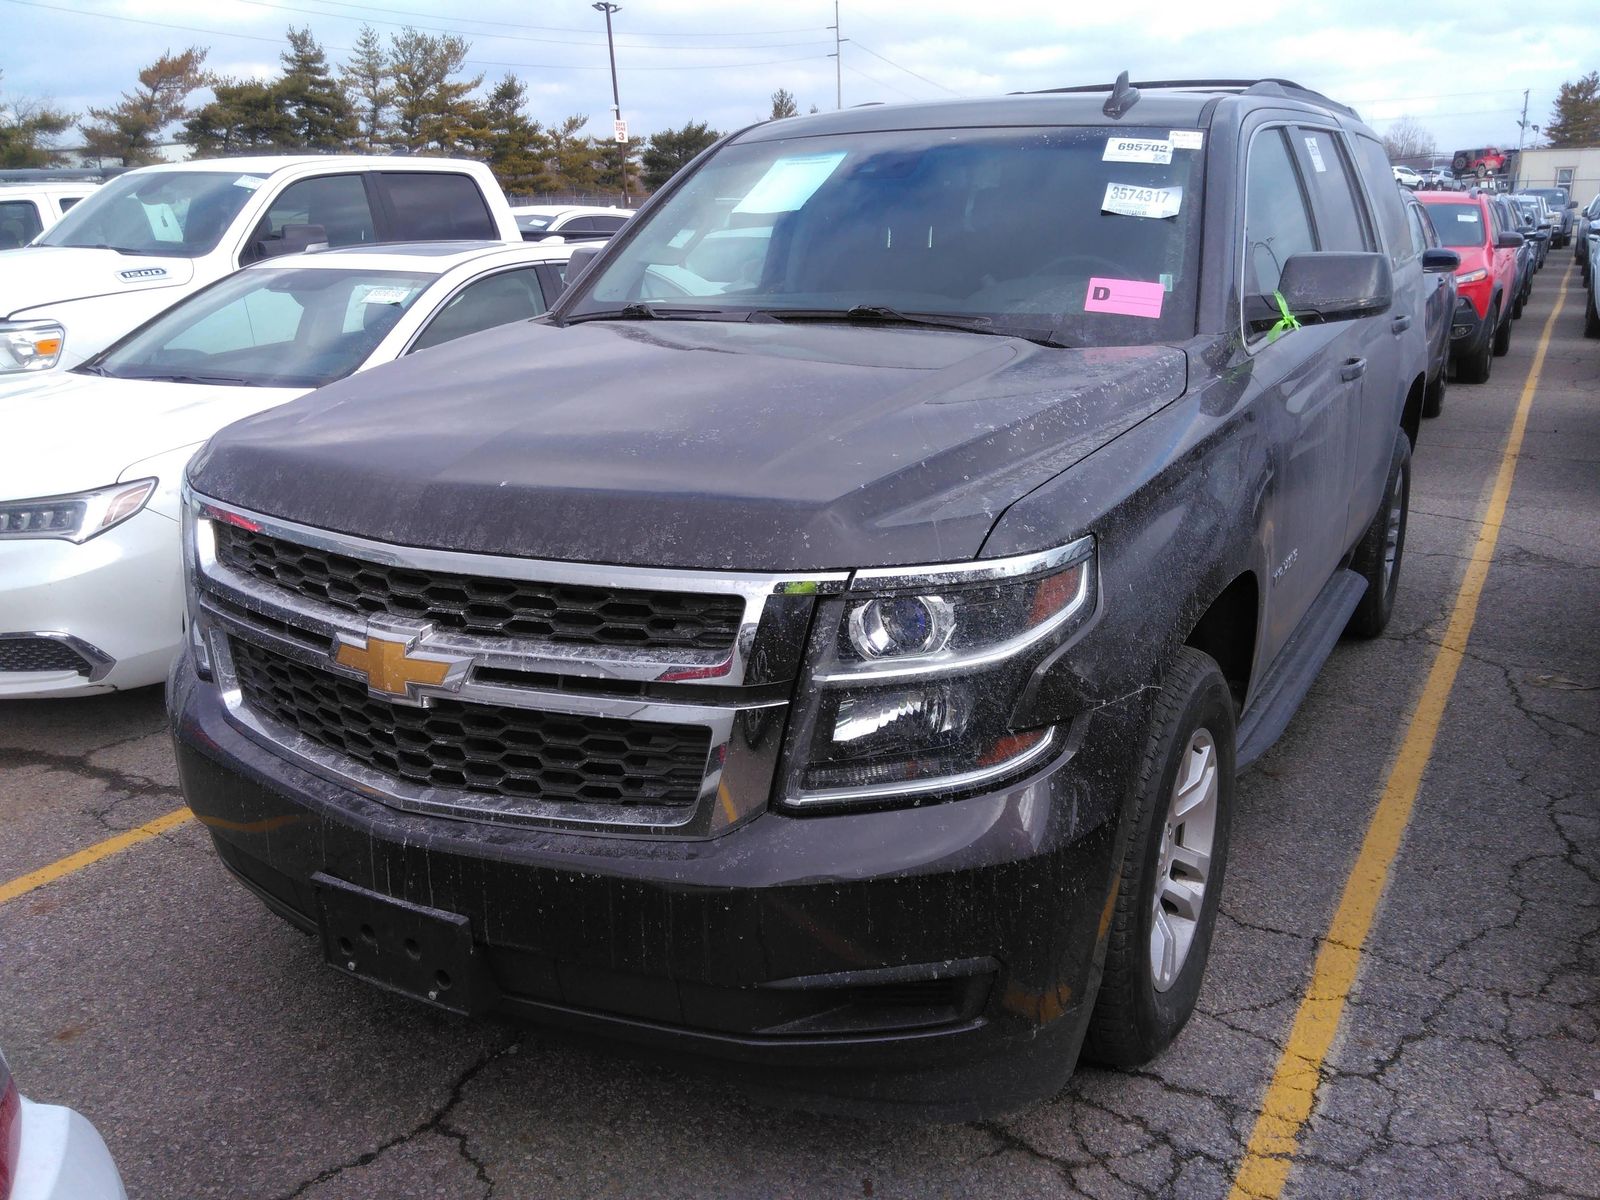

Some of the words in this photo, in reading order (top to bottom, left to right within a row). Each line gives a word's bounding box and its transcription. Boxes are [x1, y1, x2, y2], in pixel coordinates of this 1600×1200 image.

[618, 132, 625, 140] 3
[1117, 143, 1168, 153] 695702
[1111, 186, 1170, 203] 3574317
[123, 269, 160, 278] 1500
[1093, 286, 1110, 300] D
